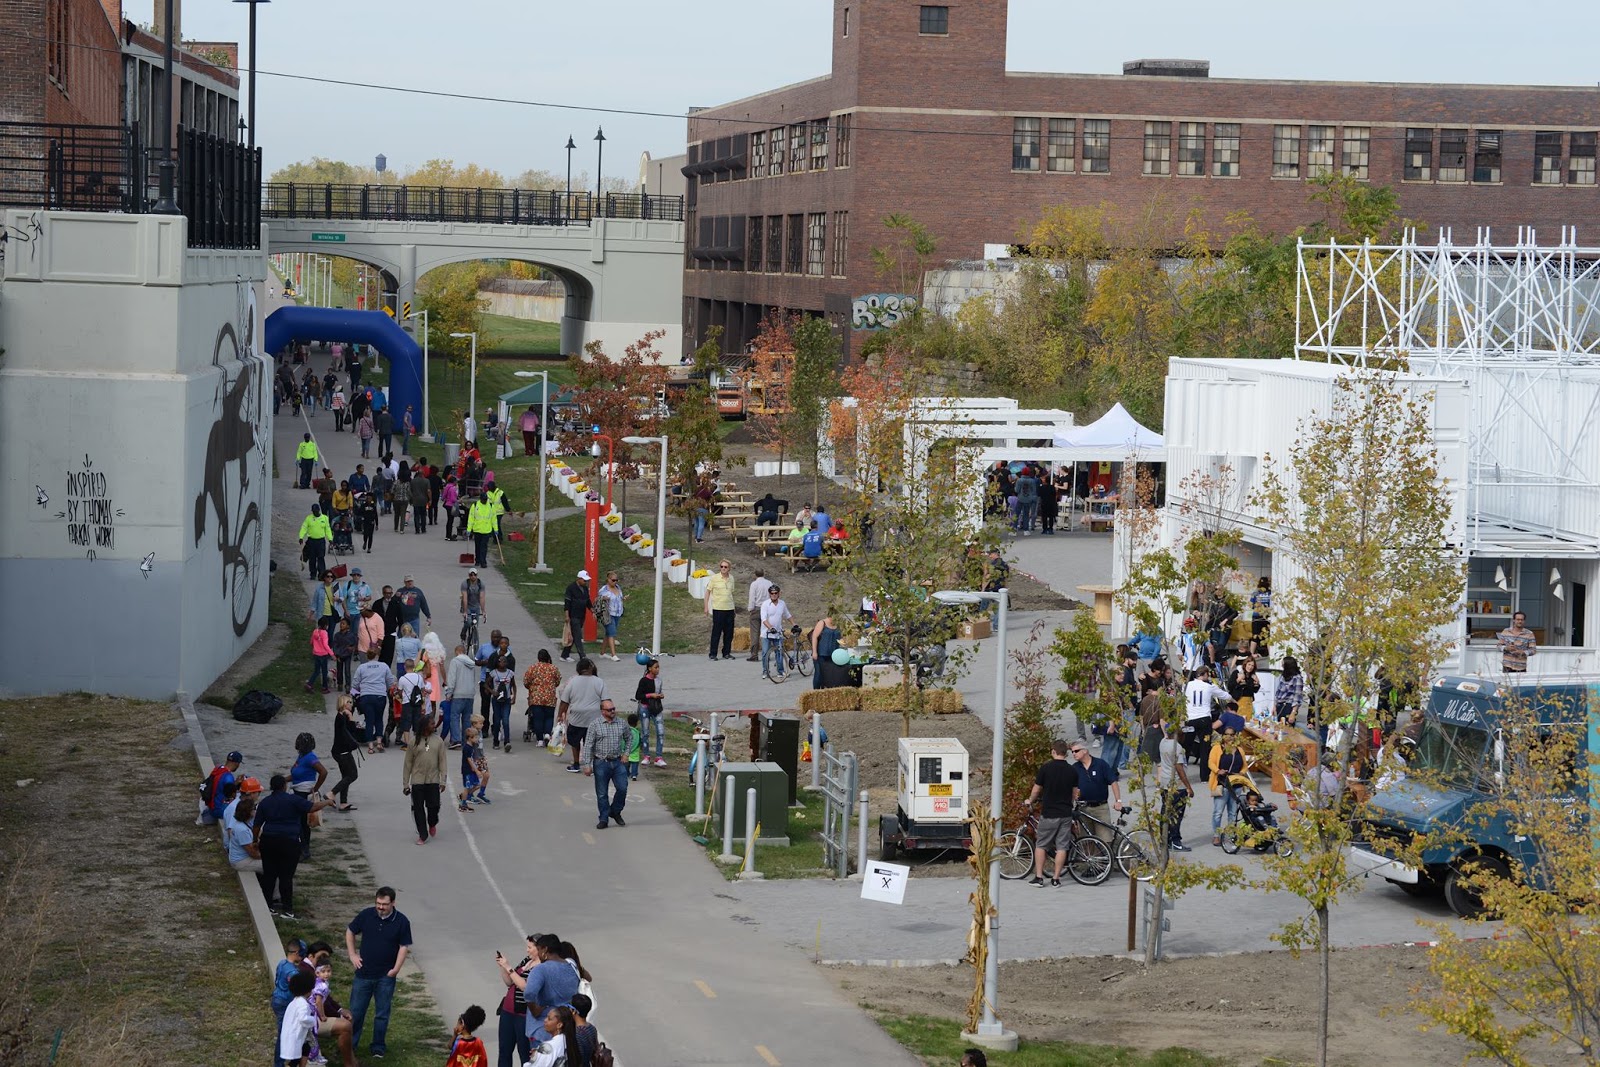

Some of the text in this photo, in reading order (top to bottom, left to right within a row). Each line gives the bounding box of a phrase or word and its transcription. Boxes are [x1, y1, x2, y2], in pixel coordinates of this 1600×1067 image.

[67, 499, 113, 526] BY THOMAS
[1193, 690, 1203, 707] 11
[1443, 699, 1476, 722] We Cater
